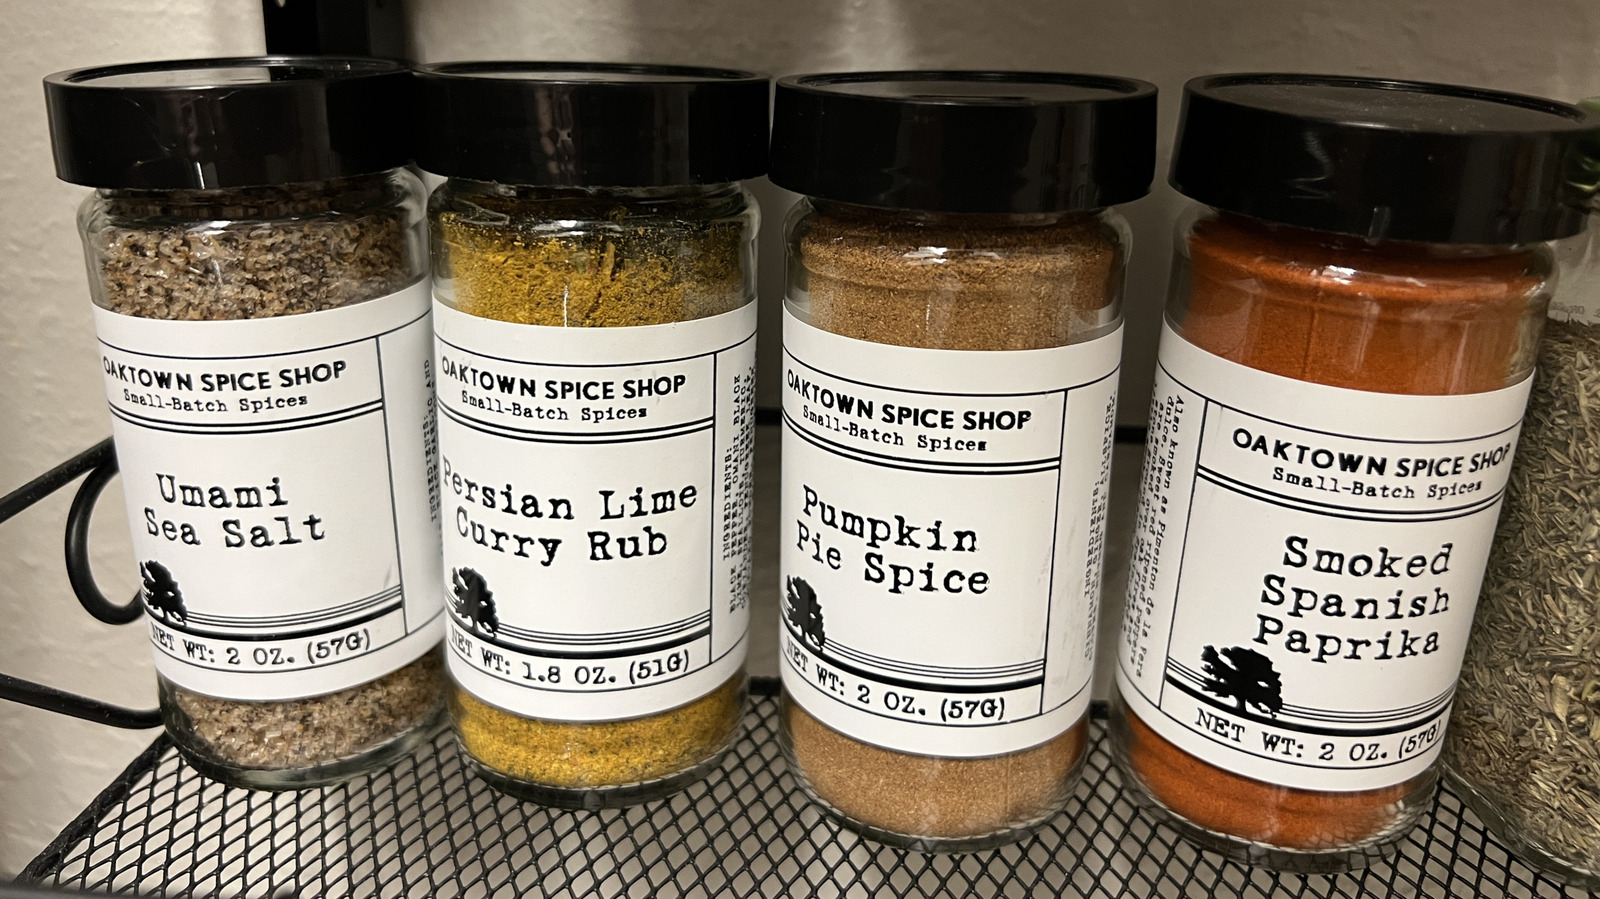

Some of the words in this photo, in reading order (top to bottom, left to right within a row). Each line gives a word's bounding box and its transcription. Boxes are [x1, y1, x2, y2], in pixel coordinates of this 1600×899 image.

[103, 356, 193, 391] OAKTOWN
[202, 371, 272, 392] SPICE
[279, 360, 347, 388] SHOP
[442, 356, 537, 398] OAKTOWN
[544, 380, 615, 401] SPICE
[622, 375, 687, 398] SHOP
[123, 388, 228, 412] Small-Batch
[239, 395, 308, 413] Spices
[461, 390, 569, 420] Small-Batch
[581, 407, 648, 423] Spices
[787, 369, 874, 419] OAKTOWN
[881, 404, 955, 429] SPICE
[963, 410, 1032, 430] SHOP
[1171, 394, 1184, 433] Also
[803, 404, 904, 446] Small-Batch
[917, 434, 988, 453] Spices
[1232, 428, 1386, 475] OAKTOWN
[1395, 455, 1463, 478] SPICE
[1468, 442, 1511, 474] SHOP
[443, 455, 575, 520] Persian
[599, 484, 698, 520] Lime
[1164, 439, 1178, 489] known
[1272, 466, 1415, 499] Small-Batch
[1426, 479, 1483, 499] Spices
[155, 473, 289, 509] Umami
[723, 448, 732, 561] INGREDIENTS:
[144, 507, 201, 545] Sea
[222, 514, 325, 548] Salt
[456, 506, 563, 567] Curry
[587, 526, 668, 561] Rub
[803, 484, 980, 552] Pumpkin
[796, 520, 842, 570] Pie
[864, 552, 990, 594] Spice
[1284, 535, 1454, 578] Smoked
[1261, 574, 1450, 620] Spanish
[152, 622, 175, 650] NET
[182, 639, 215, 664] WT:
[227, 647, 241, 665] 2
[253, 647, 296, 665] OZ.
[307, 628, 371, 664] (57G)
[452, 628, 474, 659] NET
[480, 647, 511, 675] WT:
[522, 661, 561, 684] 1.8
[575, 666, 616, 684] OZ.
[628, 649, 691, 683] (51G)
[1252, 613, 1441, 663] Paprika
[787, 634, 809, 674] NET
[816, 665, 845, 696] WT:
[857, 684, 870, 704] 2
[884, 691, 926, 715] OZ.
[940, 697, 1006, 722] (57G)
[1195, 707, 1245, 743] NET
[1261, 732, 1304, 758] WT:
[1319, 743, 1334, 760] 2
[1350, 742, 1387, 761] OZ.
[1398, 719, 1441, 759] (57G)
